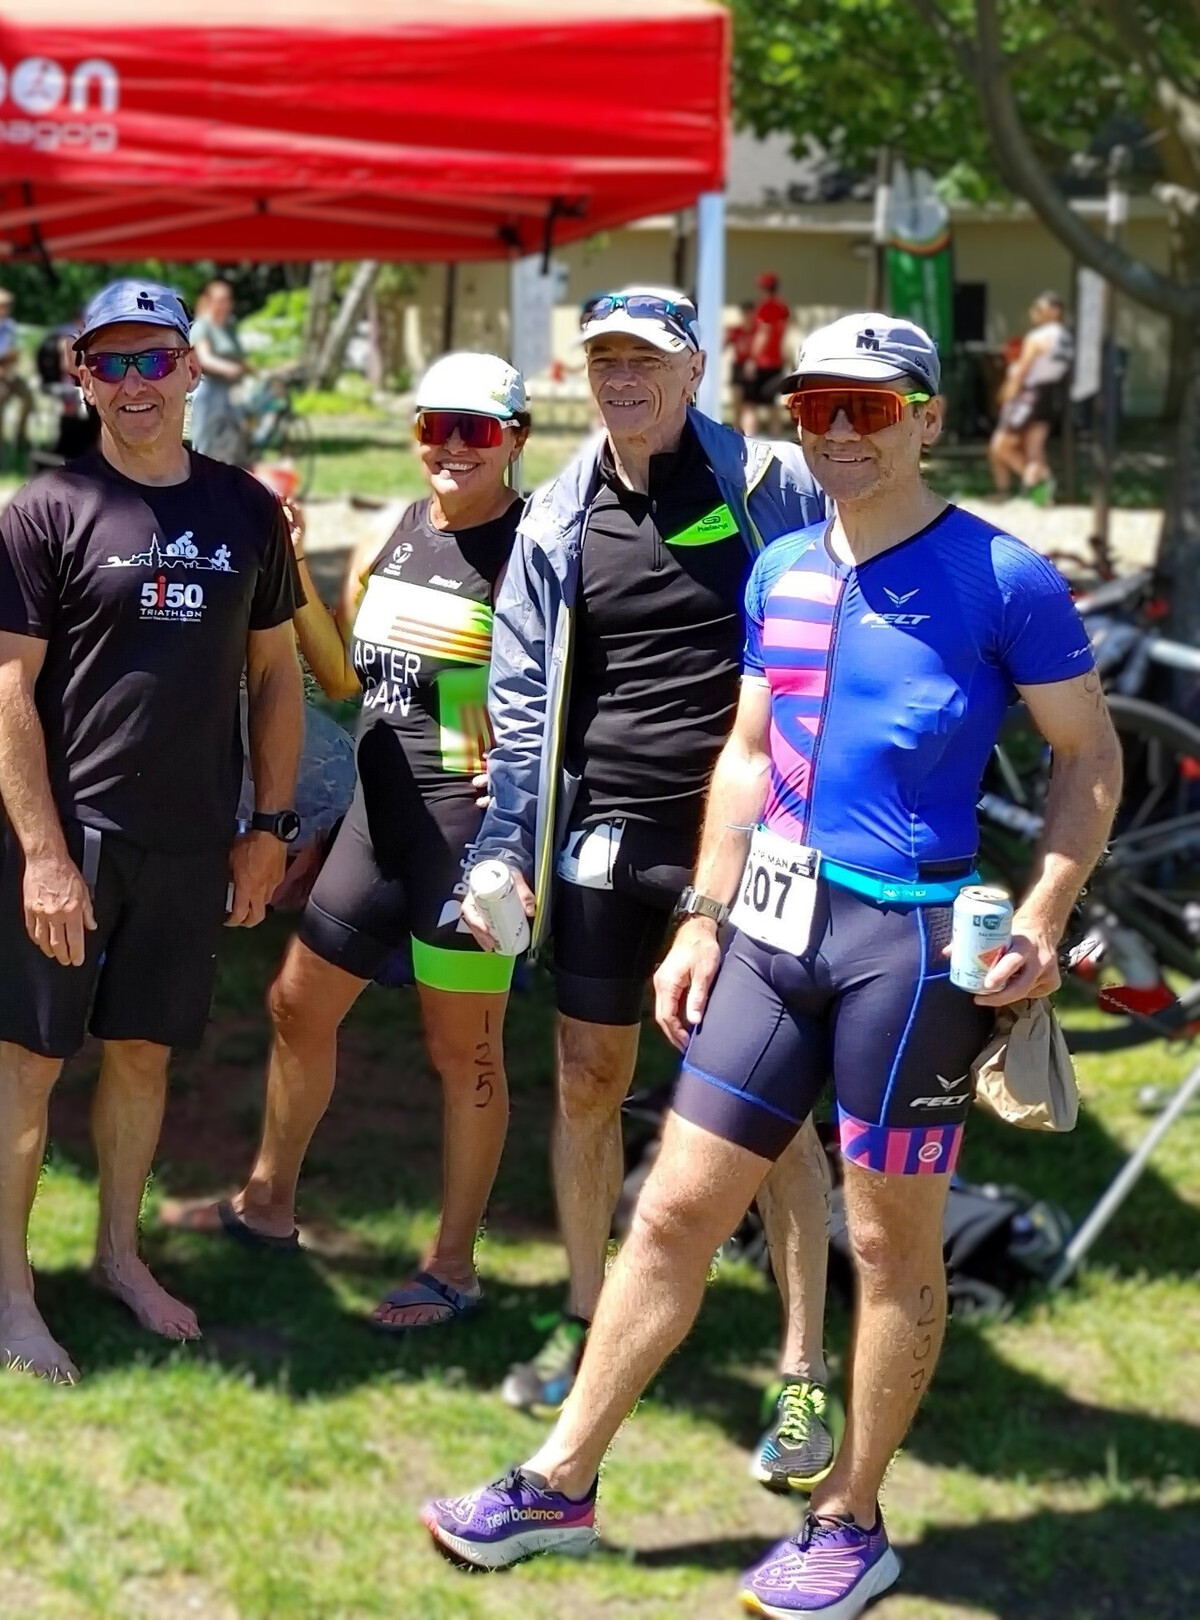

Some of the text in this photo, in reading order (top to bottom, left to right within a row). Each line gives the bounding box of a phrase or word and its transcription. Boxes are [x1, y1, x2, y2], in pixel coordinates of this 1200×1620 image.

[139, 607, 203, 618] TRIATHLON
[353, 639, 421, 689] APTER
[473, 1009, 497, 1109] 125
[486, 1506, 565, 1530] new balance
